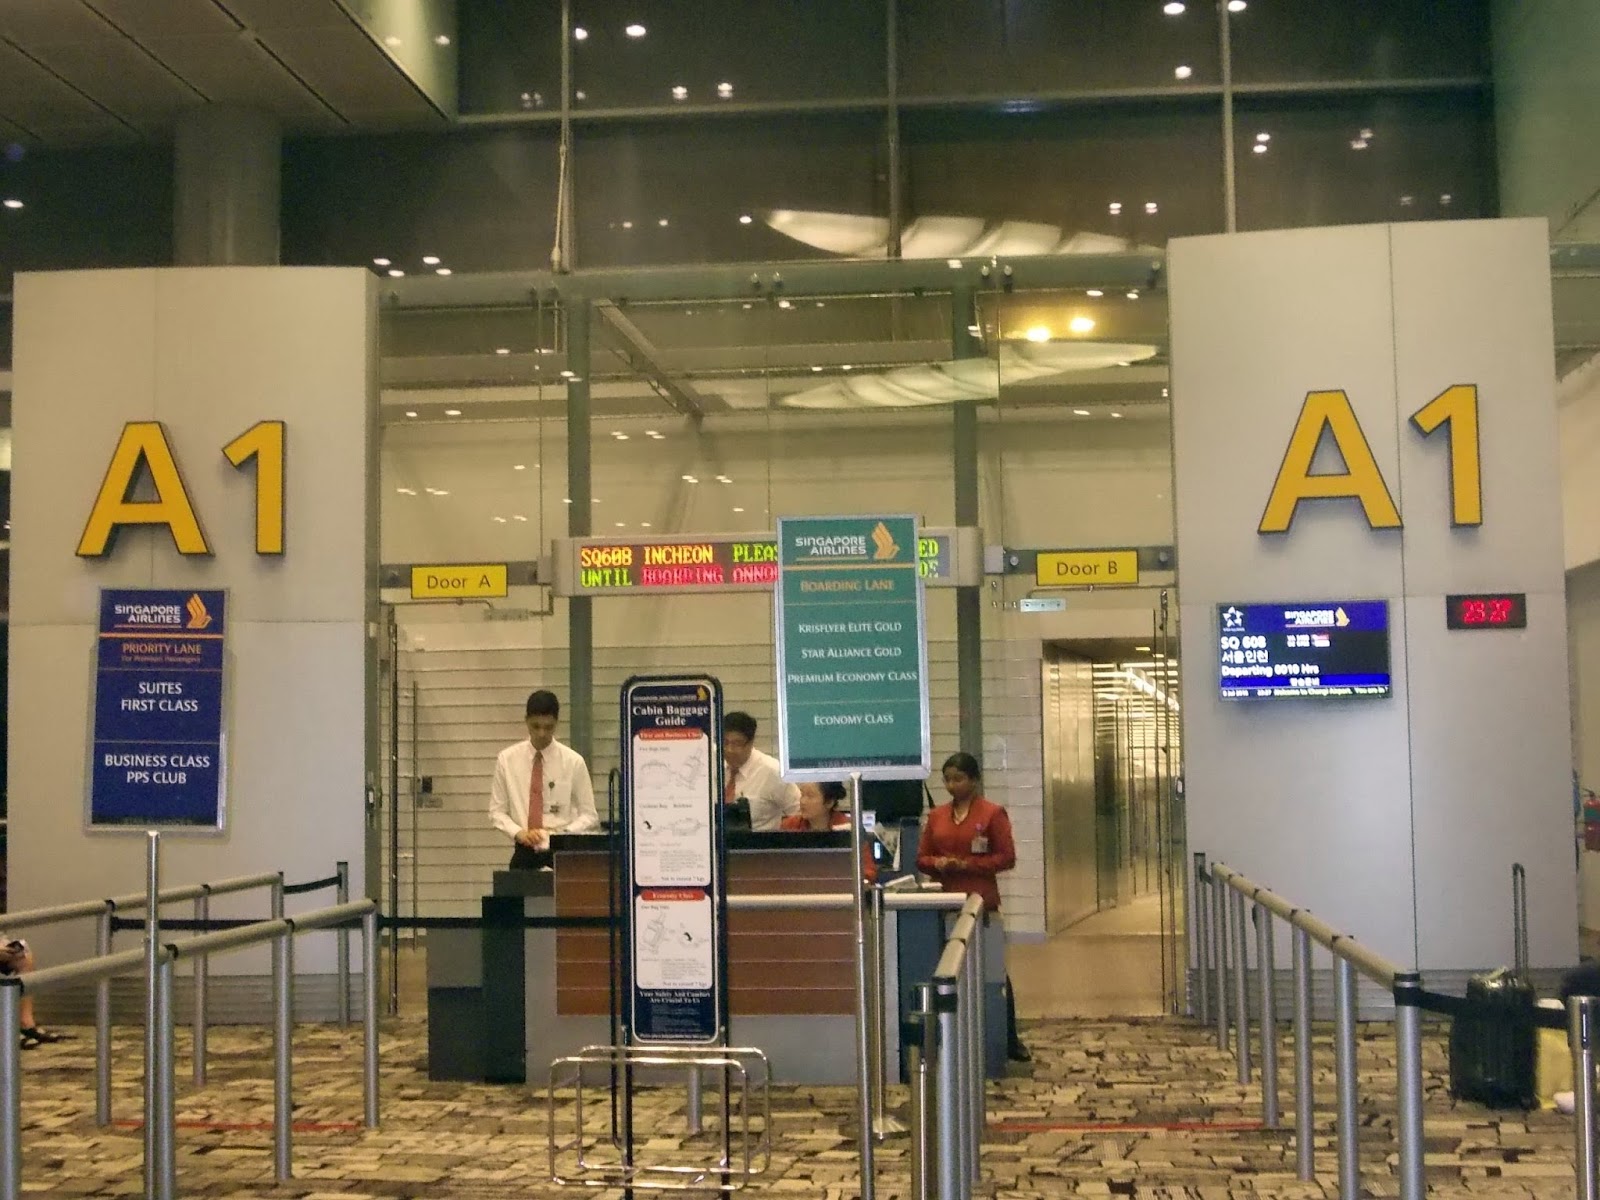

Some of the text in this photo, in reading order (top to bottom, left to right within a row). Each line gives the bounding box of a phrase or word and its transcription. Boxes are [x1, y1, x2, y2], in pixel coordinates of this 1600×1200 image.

[1257, 384, 1482, 535] A1
[75, 420, 284, 556] A1
[795, 535, 866, 547] SINGAPORE
[644, 544, 713, 565] INCHEON
[810, 545, 866, 556] AIRLINES
[1056, 561, 1118, 576] Door B
[427, 574, 491, 589] Door A
[581, 568, 633, 587] UNTIL
[642, 565, 724, 586] BOARDING
[801, 579, 895, 592] BOARDING LANE
[114, 604, 182, 615] SINGAPORE
[127, 614, 182, 624] AIRLINES
[799, 621, 902, 634] KRISFLYER ELITE GOLD
[122, 643, 202, 655] PRIORITY LANE
[1220, 635, 1267, 650] SQ 608
[802, 647, 902, 659] STAR ALLIANCE GOLD
[787, 671, 918, 683] PREMIUM ECONOMY CLASS
[1221, 664, 1273, 678] Departing
[1301, 663, 1320, 675] Hrs
[138, 682, 182, 695] SUITES
[121, 699, 198, 711] FIRST CLASS
[633, 704, 709, 717] Cabin Baggage
[654, 716, 687, 726] Guide
[814, 714, 894, 726] ECONOMY CLASS
[105, 754, 210, 768] BUSINESS CLASS
[126, 771, 187, 784] PPS CLUB
